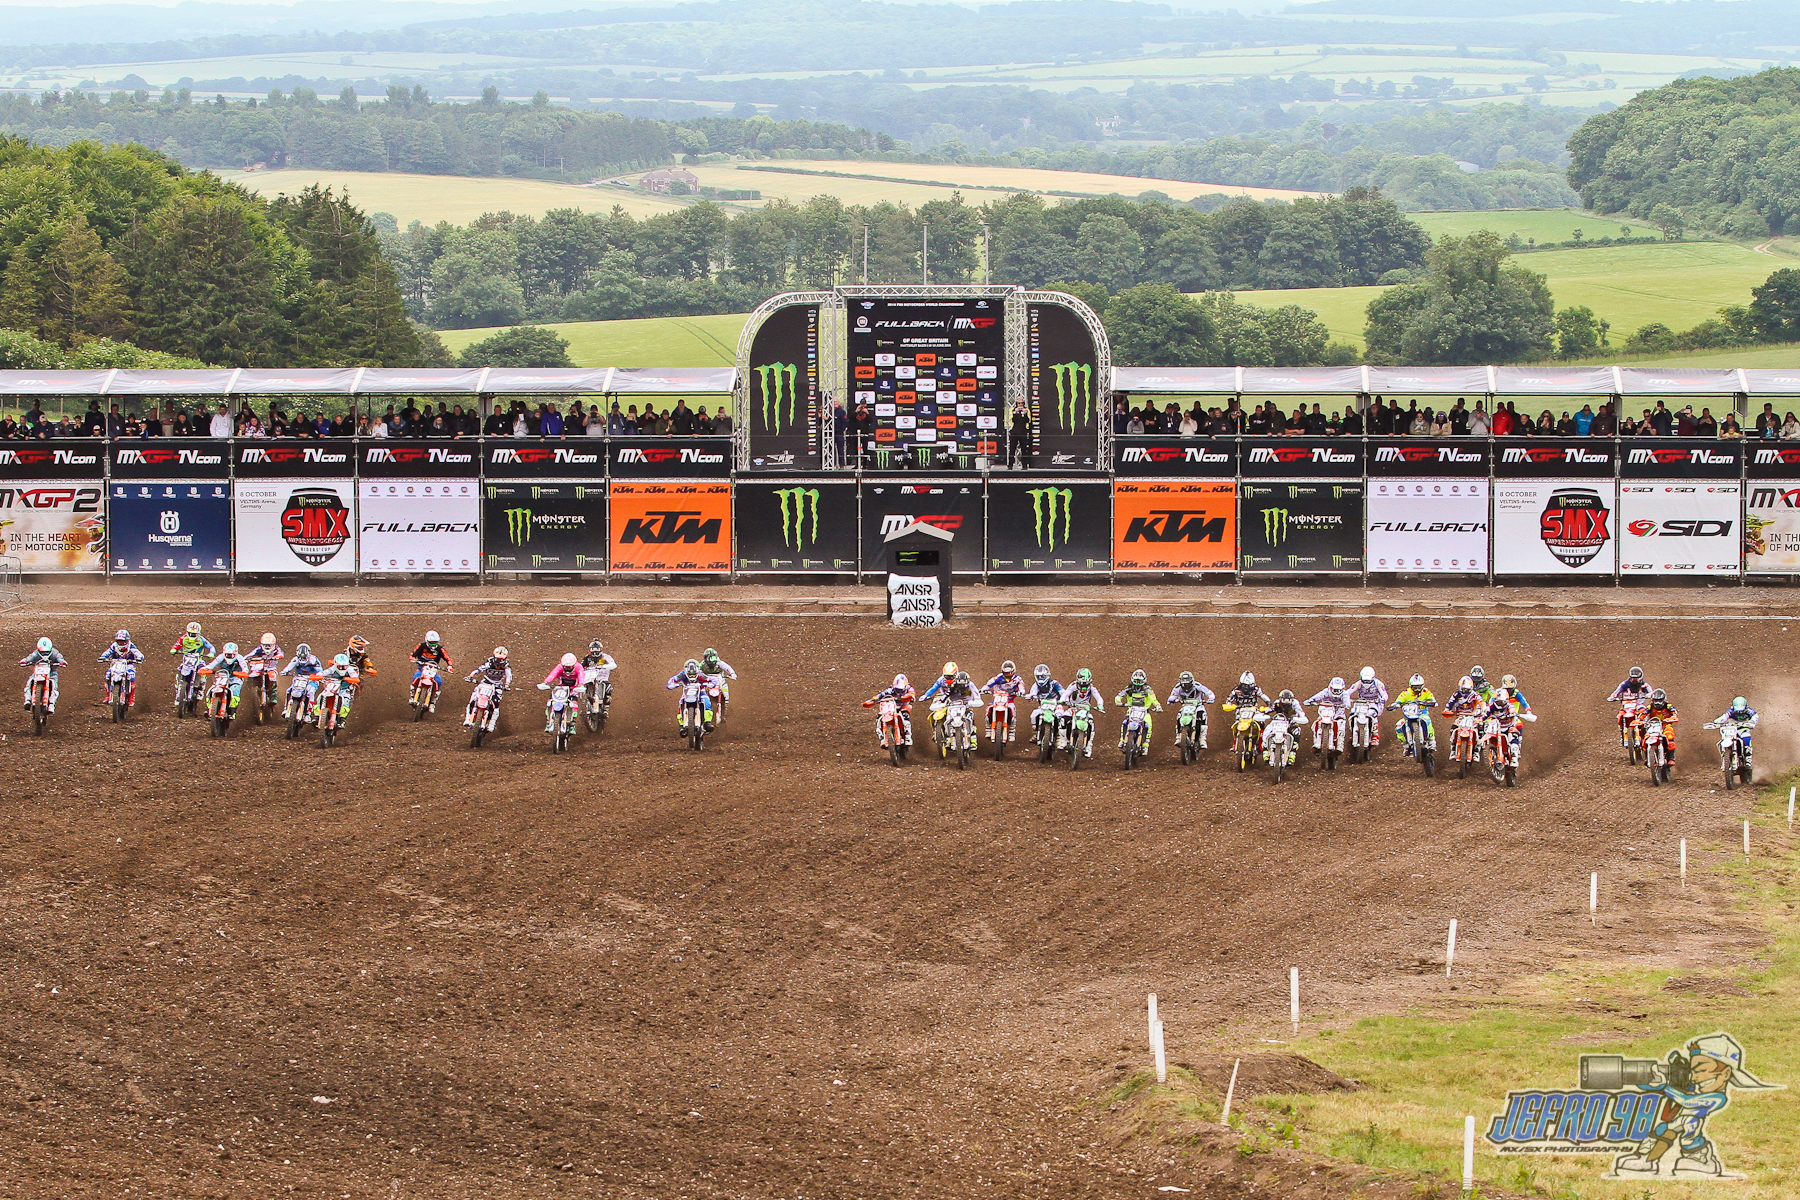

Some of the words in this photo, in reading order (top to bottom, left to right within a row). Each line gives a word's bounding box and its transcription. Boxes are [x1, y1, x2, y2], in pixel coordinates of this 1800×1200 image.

[875, 320, 945, 328] FULLBACK
[612, 486, 634, 494] KTM
[644, 486, 666, 494] KTM
[676, 486, 697, 494] KTM
[707, 486, 729, 494] KTM
[1117, 485, 1138, 493] KTM
[1148, 485, 1170, 493] KTM
[1180, 485, 1202, 493] KTM
[1212, 485, 1233, 493] KTM
[1749, 488, 1800, 509] MX
[281, 507, 350, 539] SMX
[532, 514, 586, 525] MONSTER
[1288, 514, 1343, 525] MONSTER
[1541, 508, 1609, 539] SMX
[362, 523, 479, 533] FULLBACK
[619, 511, 723, 544] KTM
[1123, 510, 1227, 543] KTM
[1369, 522, 1487, 532] FULLBACK
[1658, 520, 1733, 537] SIDI
[10, 533, 21, 542] IN
[25, 533, 46, 542] THE
[48, 533, 82, 542] HEART
[148, 534, 194, 543] Husqvarna
[1770, 533, 1781, 542] IN
[10, 543, 21, 551] OF
[25, 543, 82, 551] MOTOCROSS
[1770, 543, 1781, 551] OF
[305, 555, 326, 563] 2016
[895, 583, 932, 596] ANSR
[897, 598, 936, 612] ANSR
